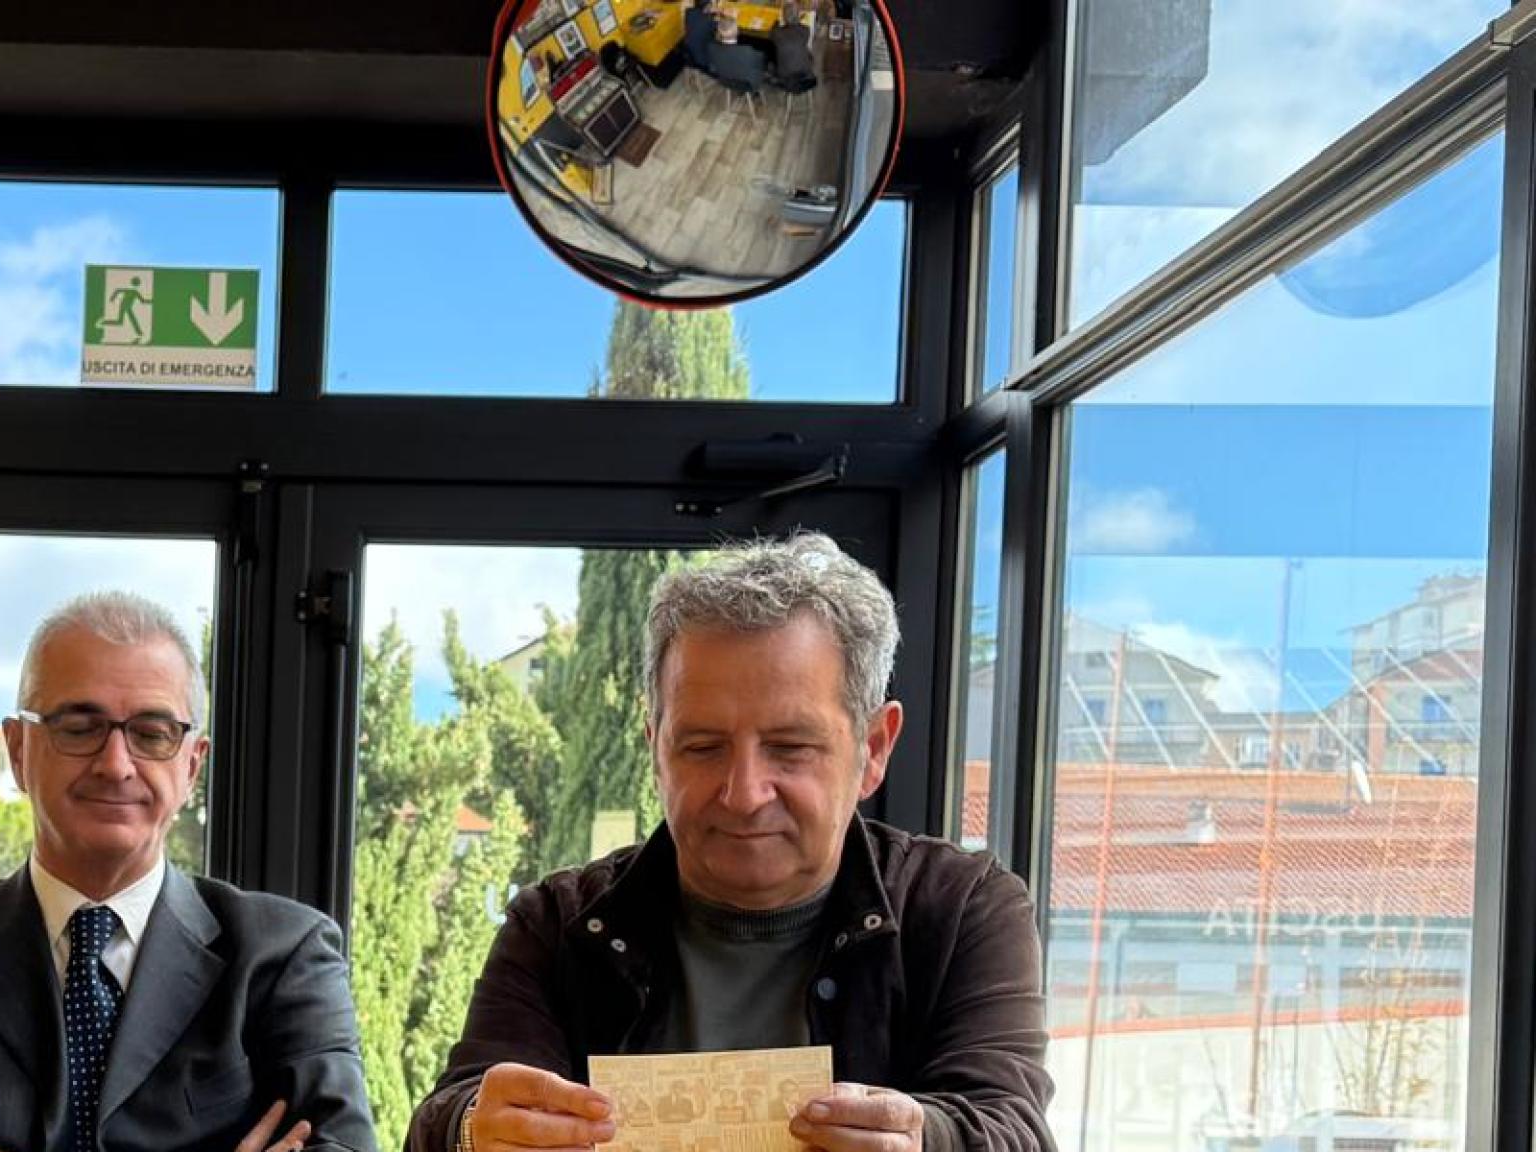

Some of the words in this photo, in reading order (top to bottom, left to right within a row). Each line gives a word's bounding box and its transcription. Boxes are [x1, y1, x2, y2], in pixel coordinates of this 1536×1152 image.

[82, 359, 137, 376] USCITA
[139, 361, 156, 376] DI
[159, 362, 256, 378] EMERGENZA
